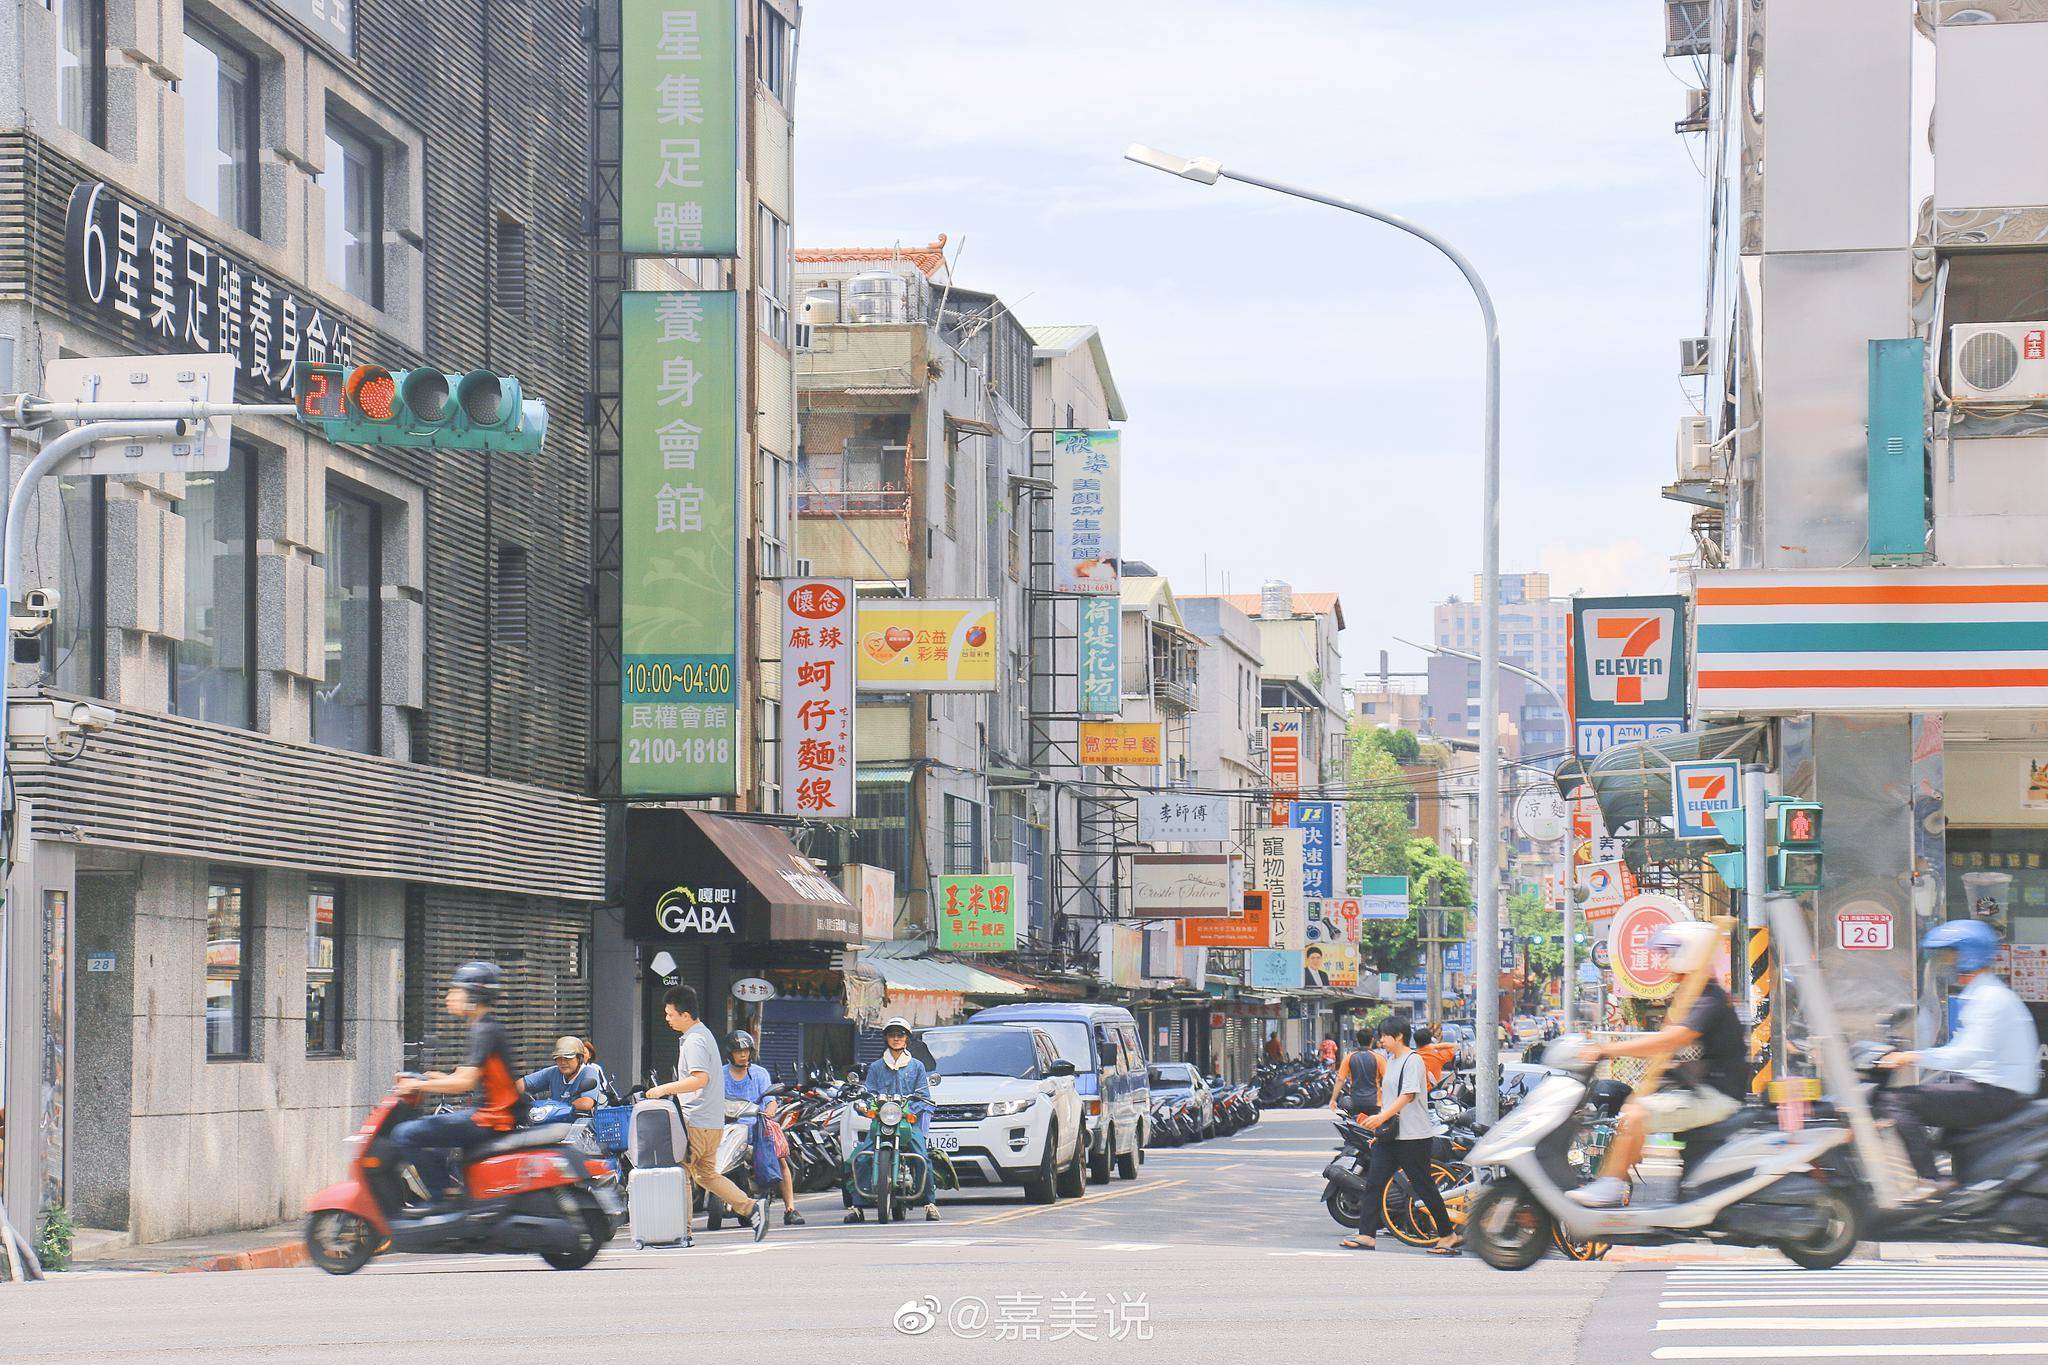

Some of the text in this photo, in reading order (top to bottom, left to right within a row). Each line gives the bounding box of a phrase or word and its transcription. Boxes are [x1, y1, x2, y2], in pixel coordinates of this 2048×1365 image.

[655, 10, 704, 250] 星集足體
[655, 293, 704, 532] 養身會館
[793, 590, 840, 611] 懷念
[788, 626, 844, 649] 麻辣
[917, 630, 947, 644] 公益
[918, 647, 948, 661] 彩券
[1597, 617, 1660, 702] 7
[627, 663, 730, 693] 10:00~04:00
[630, 705, 727, 729] 民權會館
[1272, 722, 1299, 732] SYM
[796, 659, 836, 811] 蚵仔麵線
[1619, 727, 1642, 737] ATM
[628, 738, 728, 763] 2100-1818
[1085, 736, 1156, 753] 微笑早餐
[1688, 775, 1725, 826] 7
[1160, 803, 1208, 823] 李師傅
[698, 888, 736, 904] 嘎吧!
[662, 905, 736, 934] GABA
[952, 919, 1007, 938] 早午餐店
[1854, 927, 1877, 943] 26
[93, 960, 110, 970] 28
